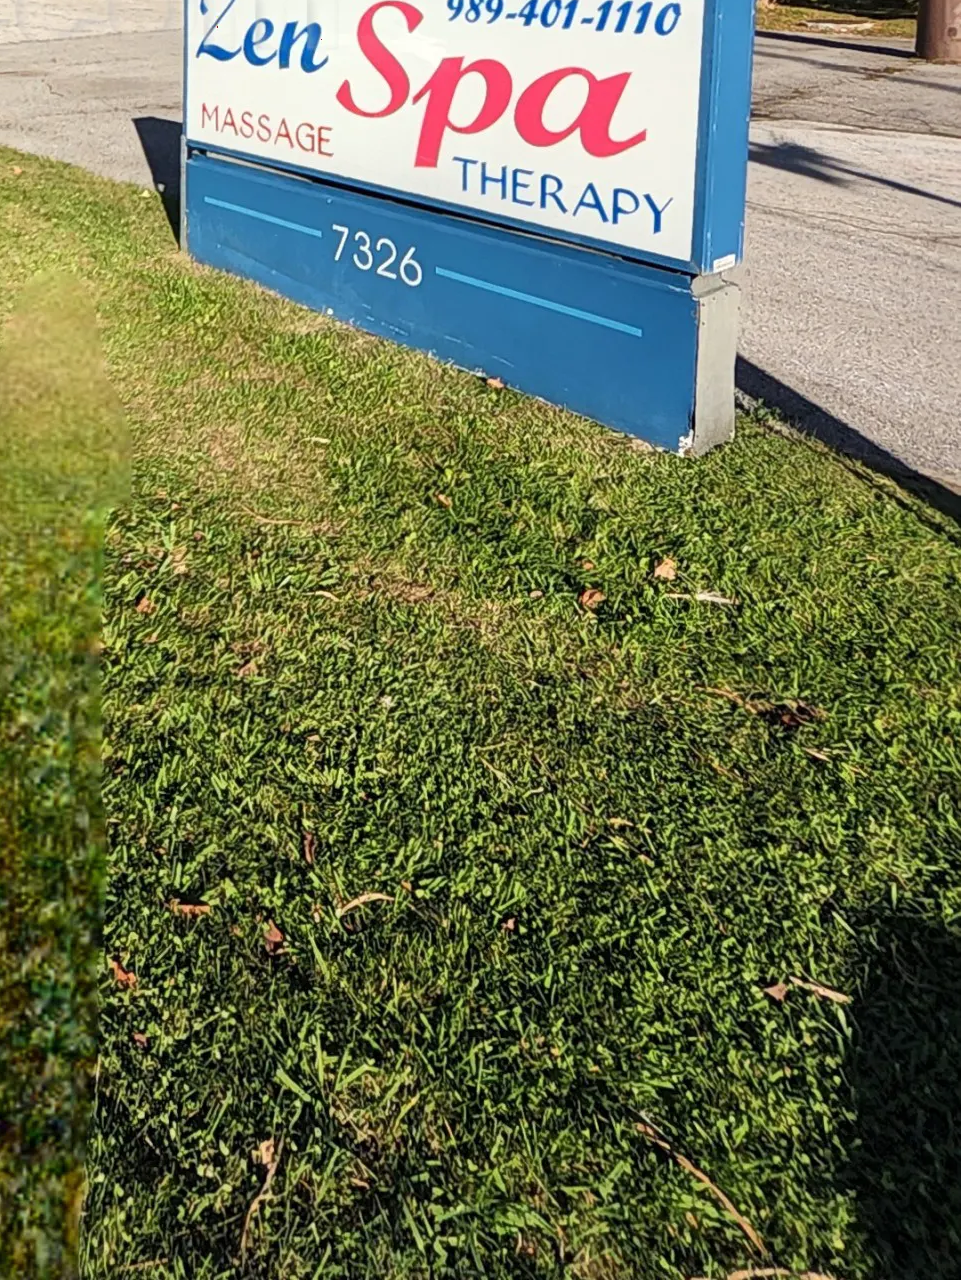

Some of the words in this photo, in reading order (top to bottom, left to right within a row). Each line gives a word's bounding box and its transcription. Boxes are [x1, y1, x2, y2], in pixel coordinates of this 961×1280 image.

[335, 0, 647, 168] Spa
[201, 102, 334, 158] MASSAGE
[452, 156, 673, 235] THERAPY
[331, 224, 424, 287] 7326
